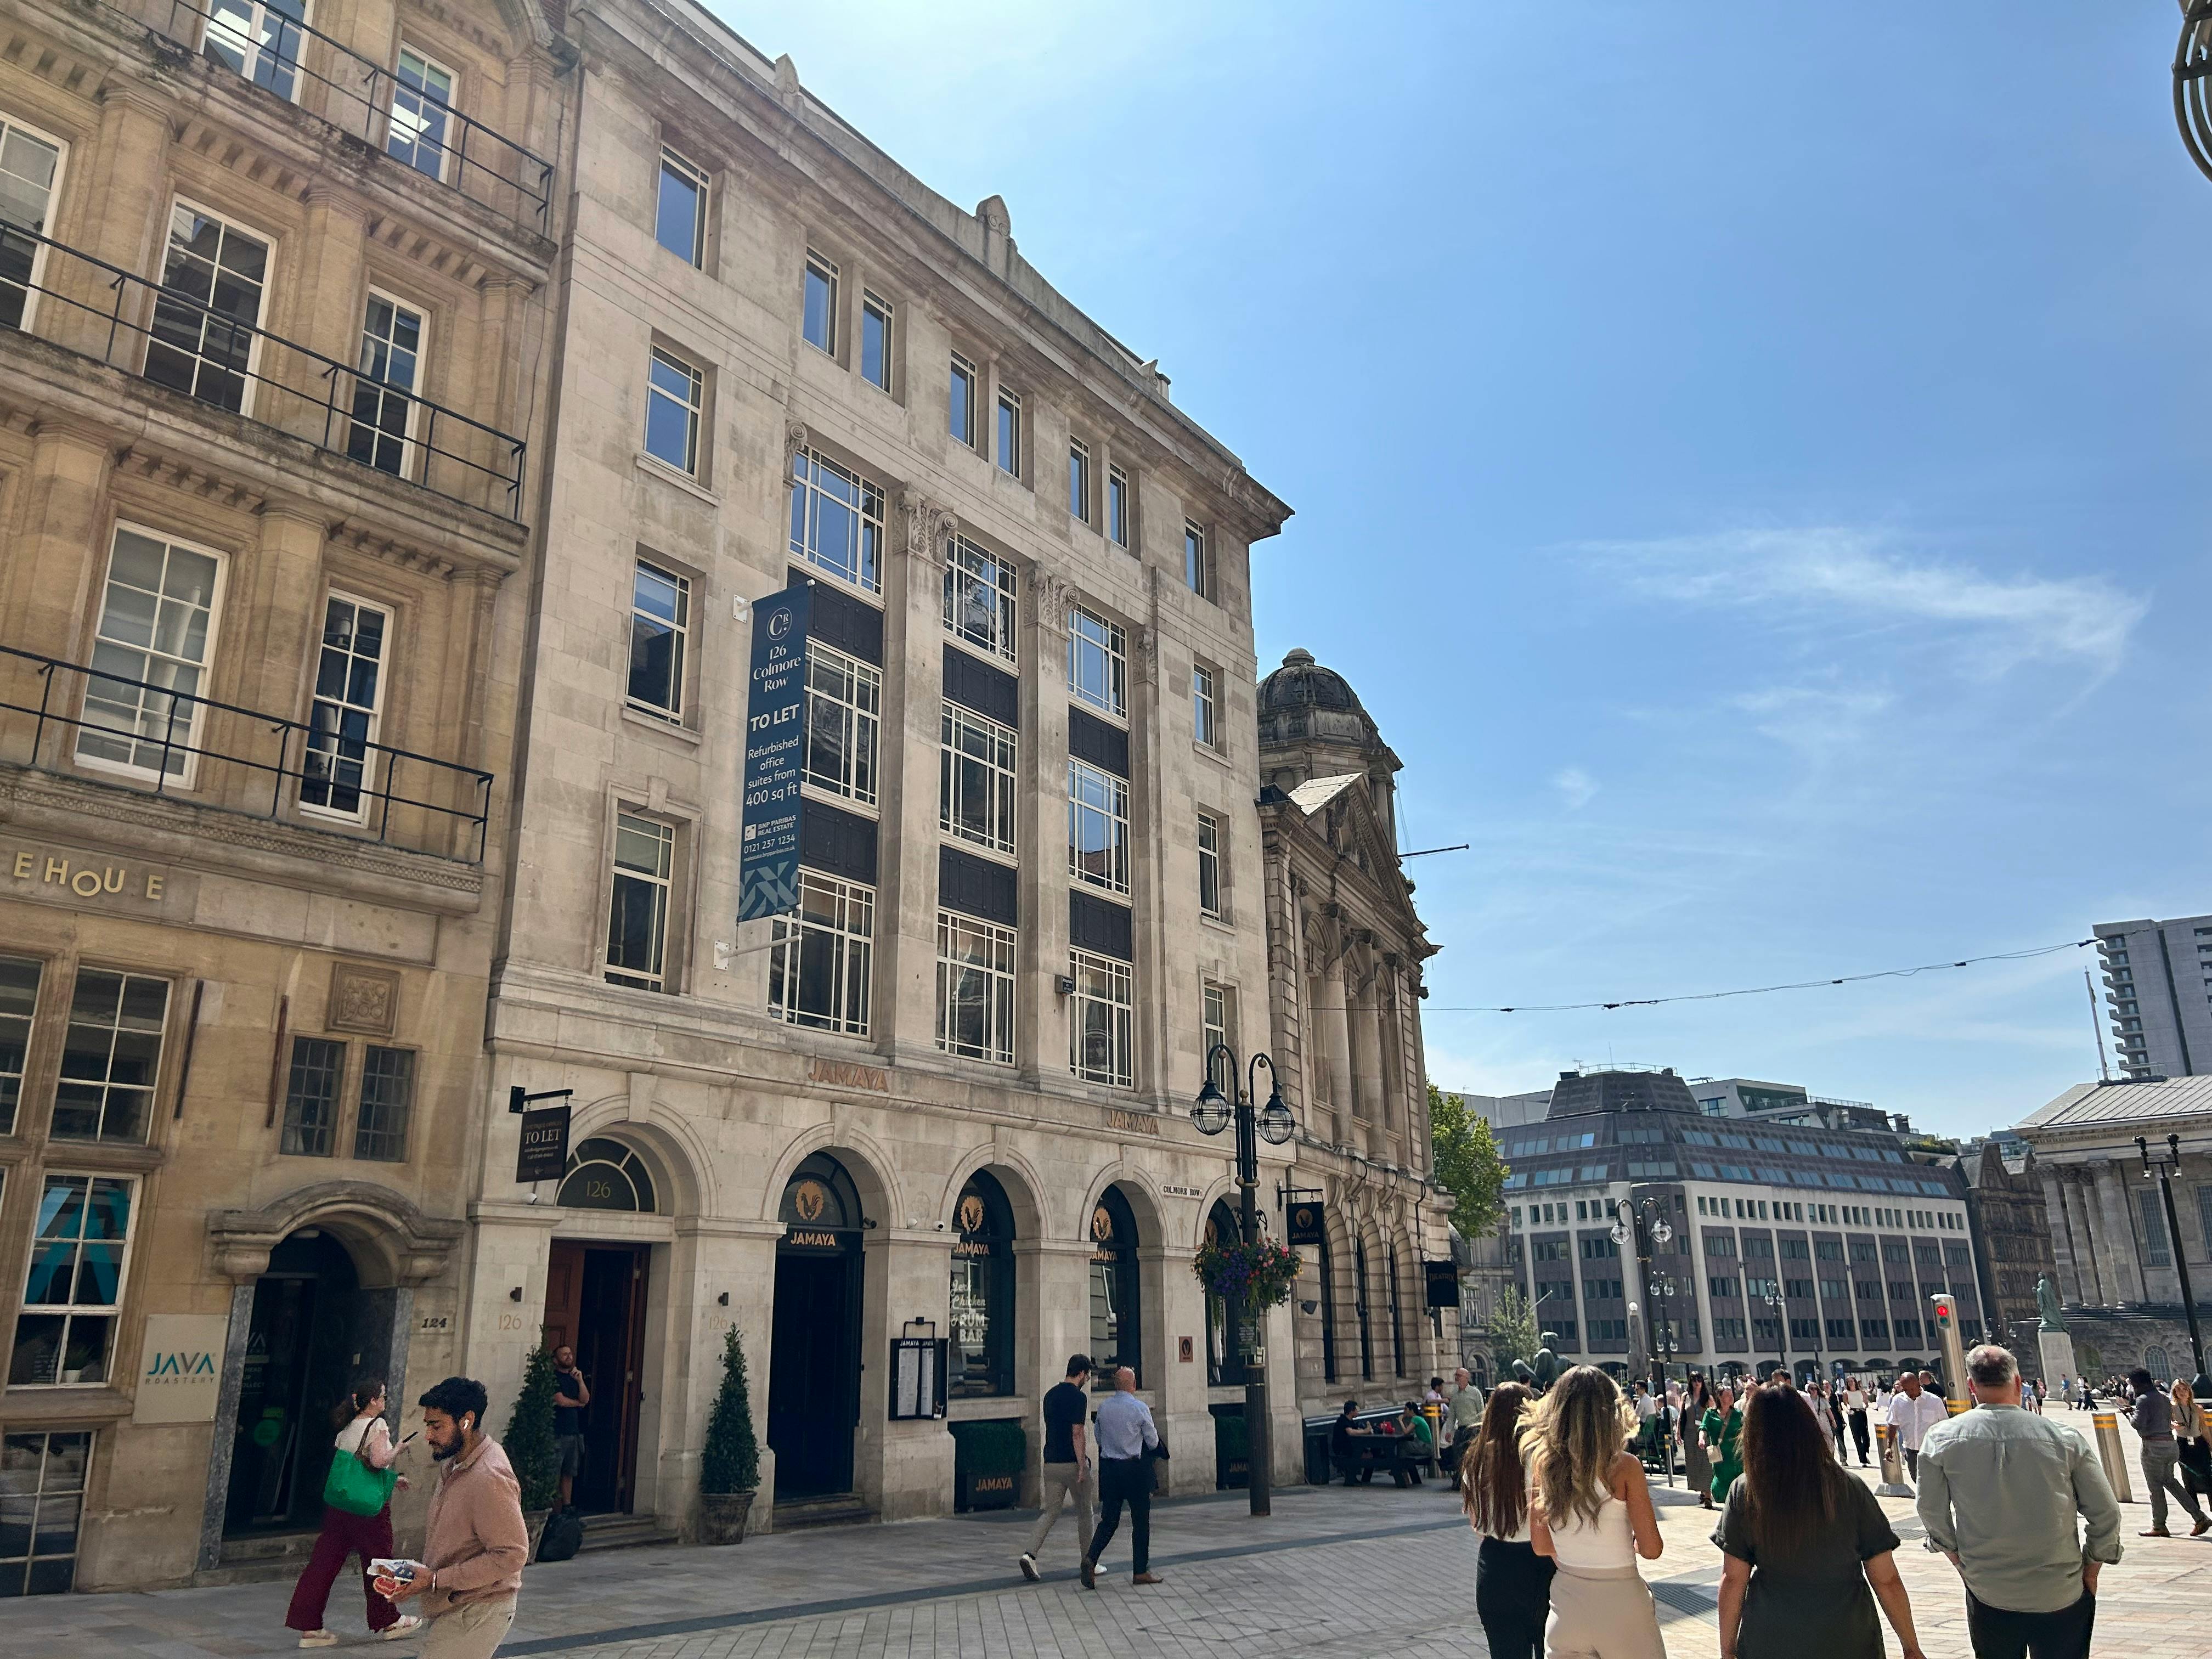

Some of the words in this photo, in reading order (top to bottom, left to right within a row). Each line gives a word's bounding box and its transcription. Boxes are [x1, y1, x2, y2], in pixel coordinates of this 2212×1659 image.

[770, 644, 787, 660] 126
[753, 657, 802, 680] Colmore
[764, 676, 789, 692] Row
[750, 713, 770, 731] TO
[774, 703, 800, 725] LET
[748, 735, 799, 760] Refurbished
[760, 757, 785, 770] office
[748, 775, 772, 789] suites
[774, 769, 795, 781] from
[746, 789, 768, 806] 400
[771, 788, 783, 801] sq
[787, 781, 797, 796] ft
[771, 815, 797, 826] PARIBAS
[758, 828, 772, 836] REAL
[773, 822, 794, 832] ESTATE
[744, 843, 760, 854] 0121
[761, 838, 775, 849] 237
[778, 834, 795, 845] 1234
[808, 1060, 889, 1092] JAMAYA
[1107, 1110, 1159, 1135] JAMAYA
[526, 1131, 539, 1144] TO
[541, 1128, 561, 1142] LET
[587, 1181, 611, 1198] 126
[1163, 1186, 1188, 1195] COLMORE
[791, 1232, 836, 1246] JAMAYA
[953, 1243, 990, 1255] JAMAYA
[1090, 1250, 1118, 1261] AMAYA
[421, 1317, 447, 1328] 124
[499, 1314, 522, 1330] 126
[709, 1316, 727, 1330] 126
[960, 1313, 985, 1327] RUM
[960, 1329, 984, 1342] BAR
[147, 1352, 215, 1375] JAVA
[975, 1477, 1013, 1492] JAMAYA
